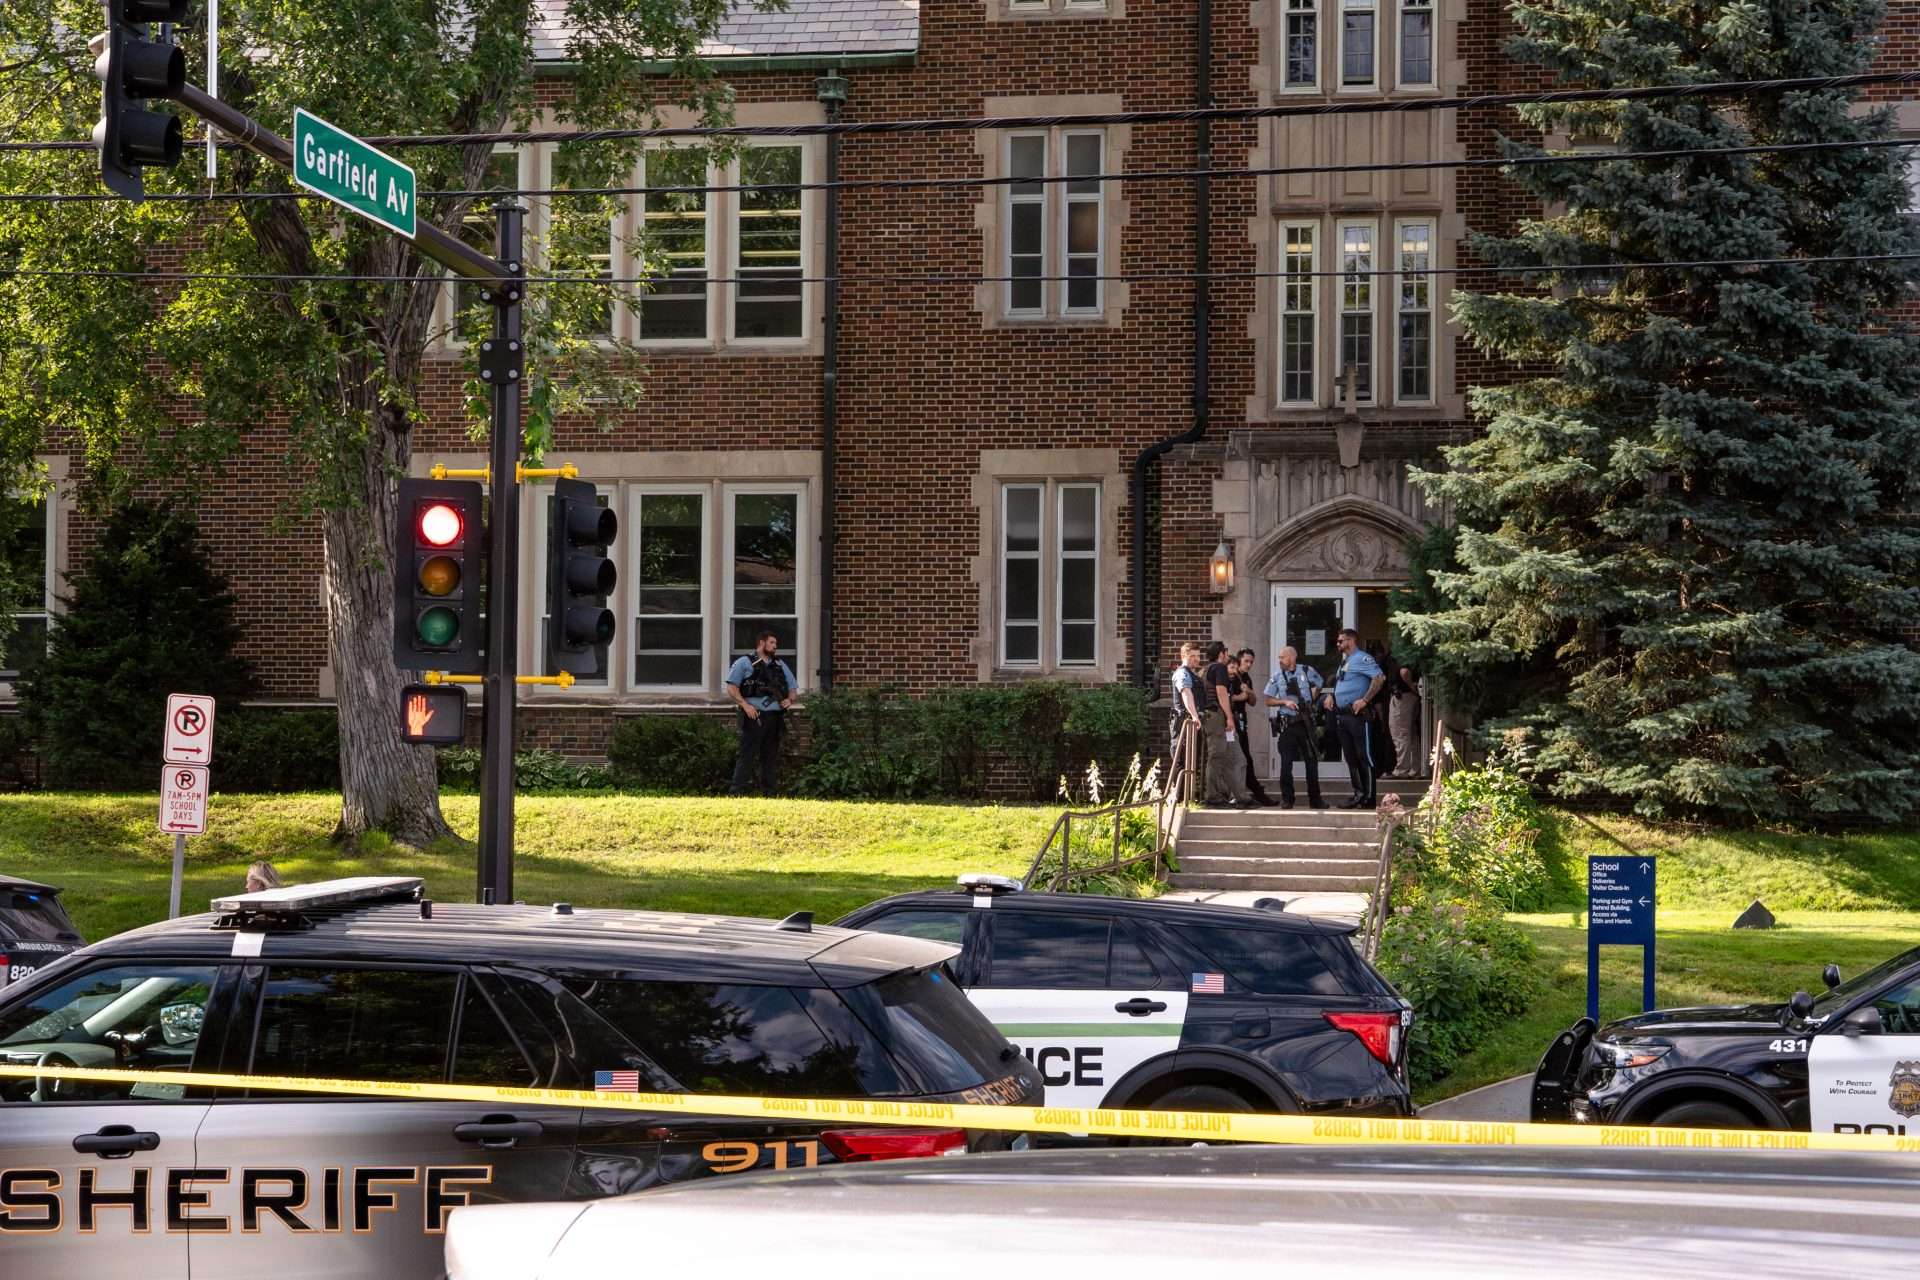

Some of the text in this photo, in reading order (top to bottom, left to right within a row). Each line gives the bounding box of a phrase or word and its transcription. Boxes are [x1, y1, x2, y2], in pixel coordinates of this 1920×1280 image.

[304, 133, 408, 216] Garfield Av
[168, 790, 202, 800] 7AM-5PM
[170, 801, 197, 811] SCHOOL
[173, 811, 193, 821] DAYS
[1592, 862, 1619, 871] School
[1769, 1039, 1807, 1053] 431
[702, 1140, 819, 1173] 911
[0, 1165, 493, 1235] SHERIFF
